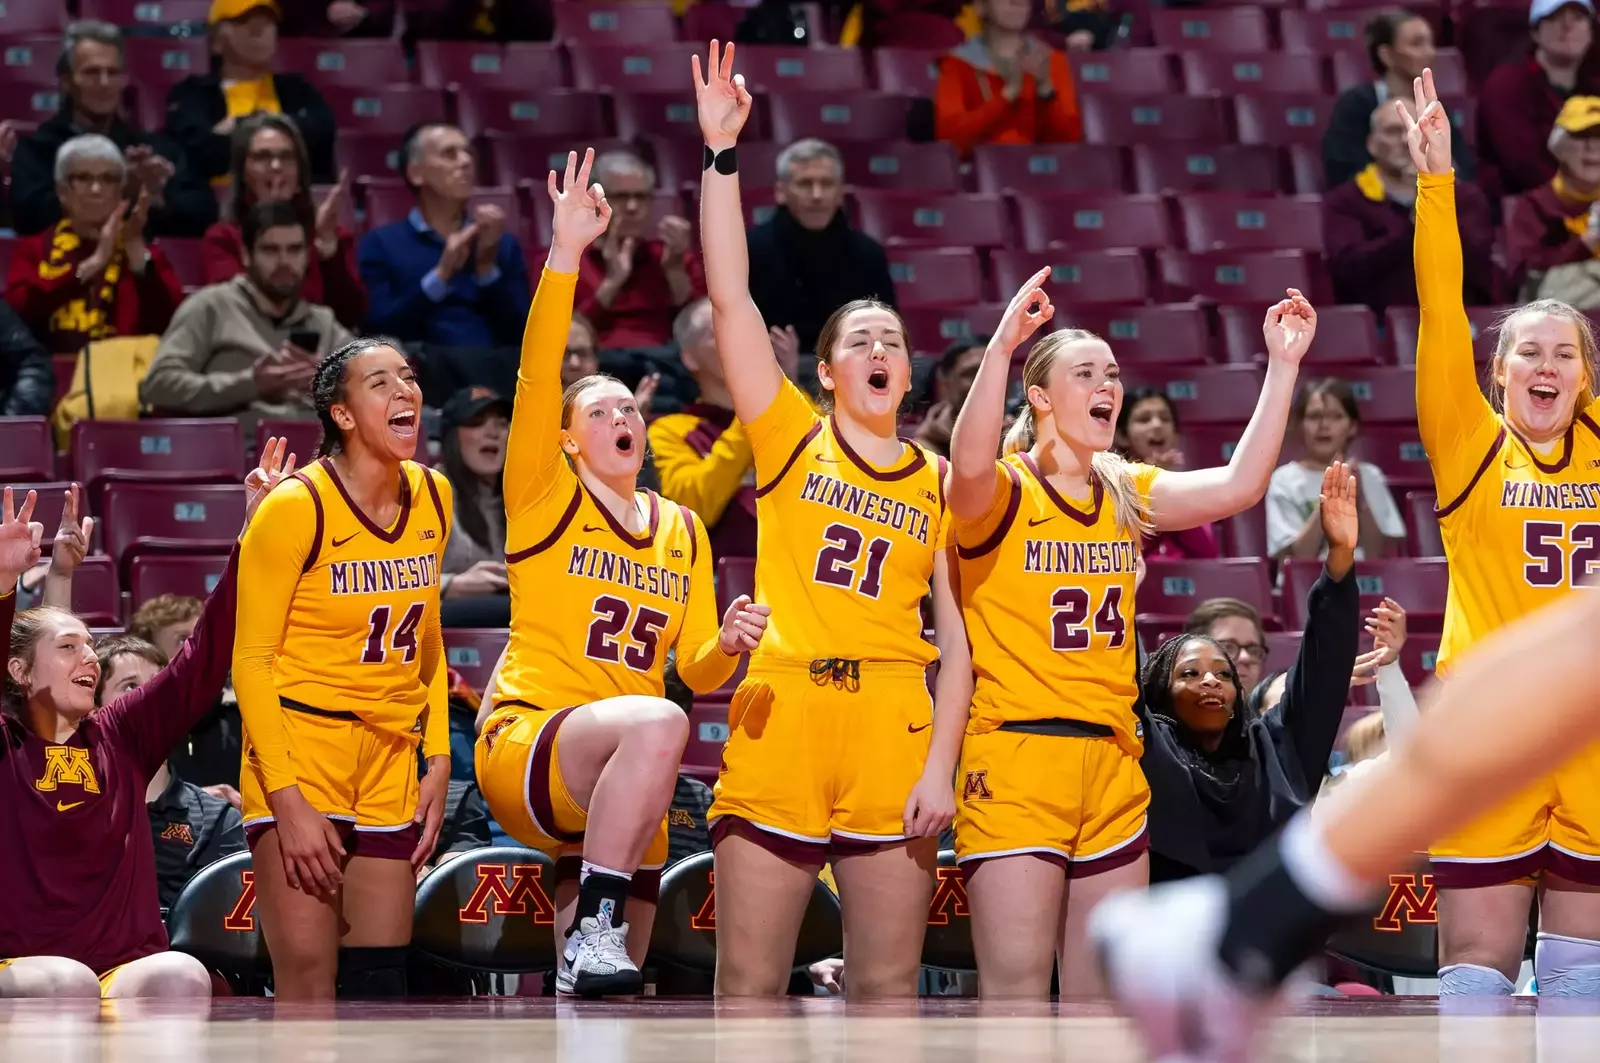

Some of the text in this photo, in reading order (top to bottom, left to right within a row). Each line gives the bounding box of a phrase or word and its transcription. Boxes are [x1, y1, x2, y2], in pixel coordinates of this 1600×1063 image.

[800, 472, 930, 546] MINNESOTA
[813, 522, 893, 600] 21
[1523, 520, 1600, 588] 52
[360, 601, 426, 664] 14
[585, 594, 670, 673] 25
[1050, 585, 1126, 651] 24
[36, 746, 101, 794] M
[963, 770, 993, 799] M
[160, 822, 194, 845] M
[458, 863, 554, 924] M
